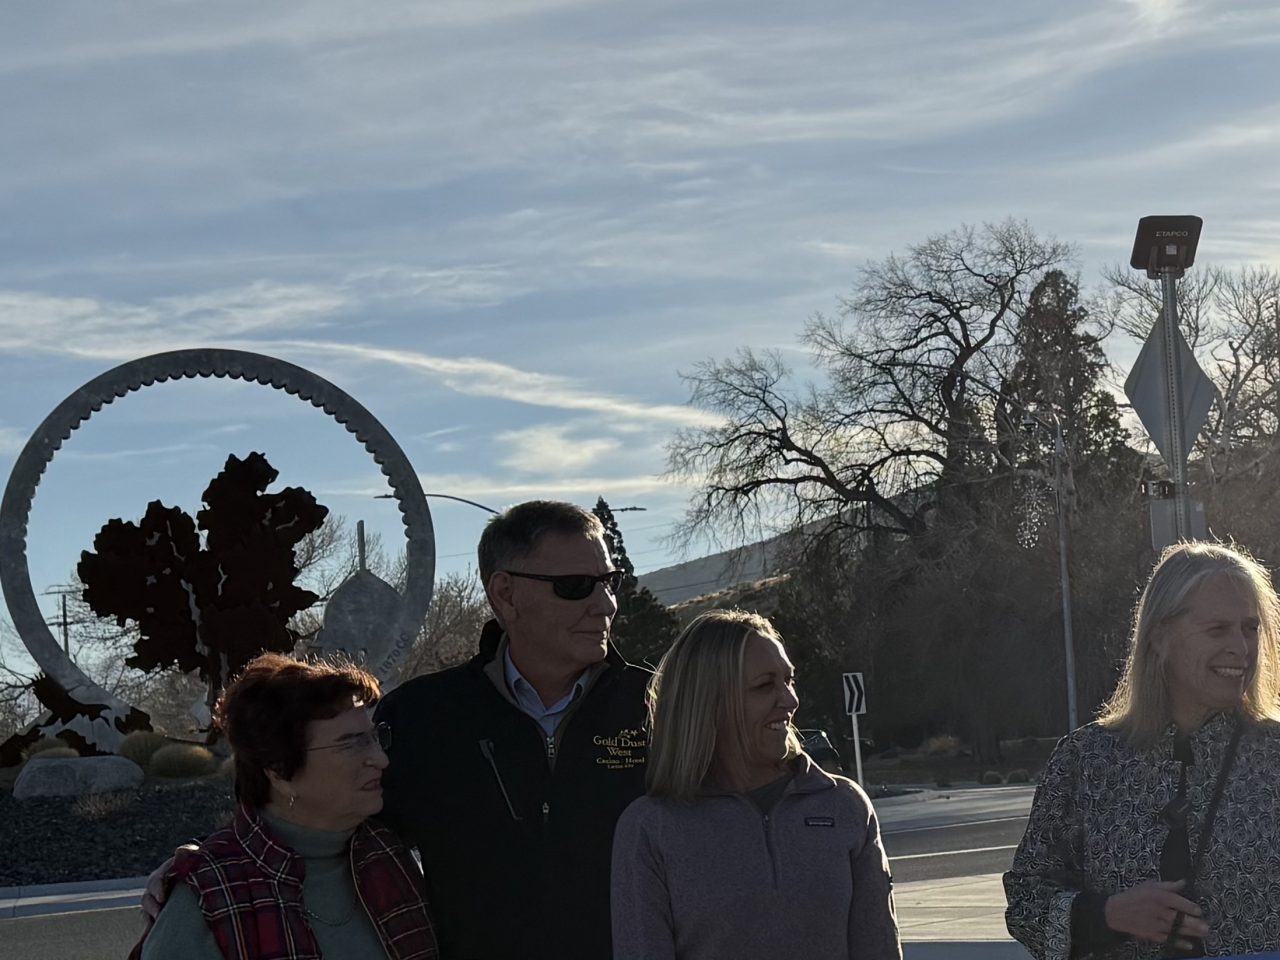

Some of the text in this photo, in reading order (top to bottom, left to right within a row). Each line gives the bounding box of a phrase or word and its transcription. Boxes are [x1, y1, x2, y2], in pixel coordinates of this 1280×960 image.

[593, 735, 646, 747] Gold Dust
[606, 746, 632, 756] West
